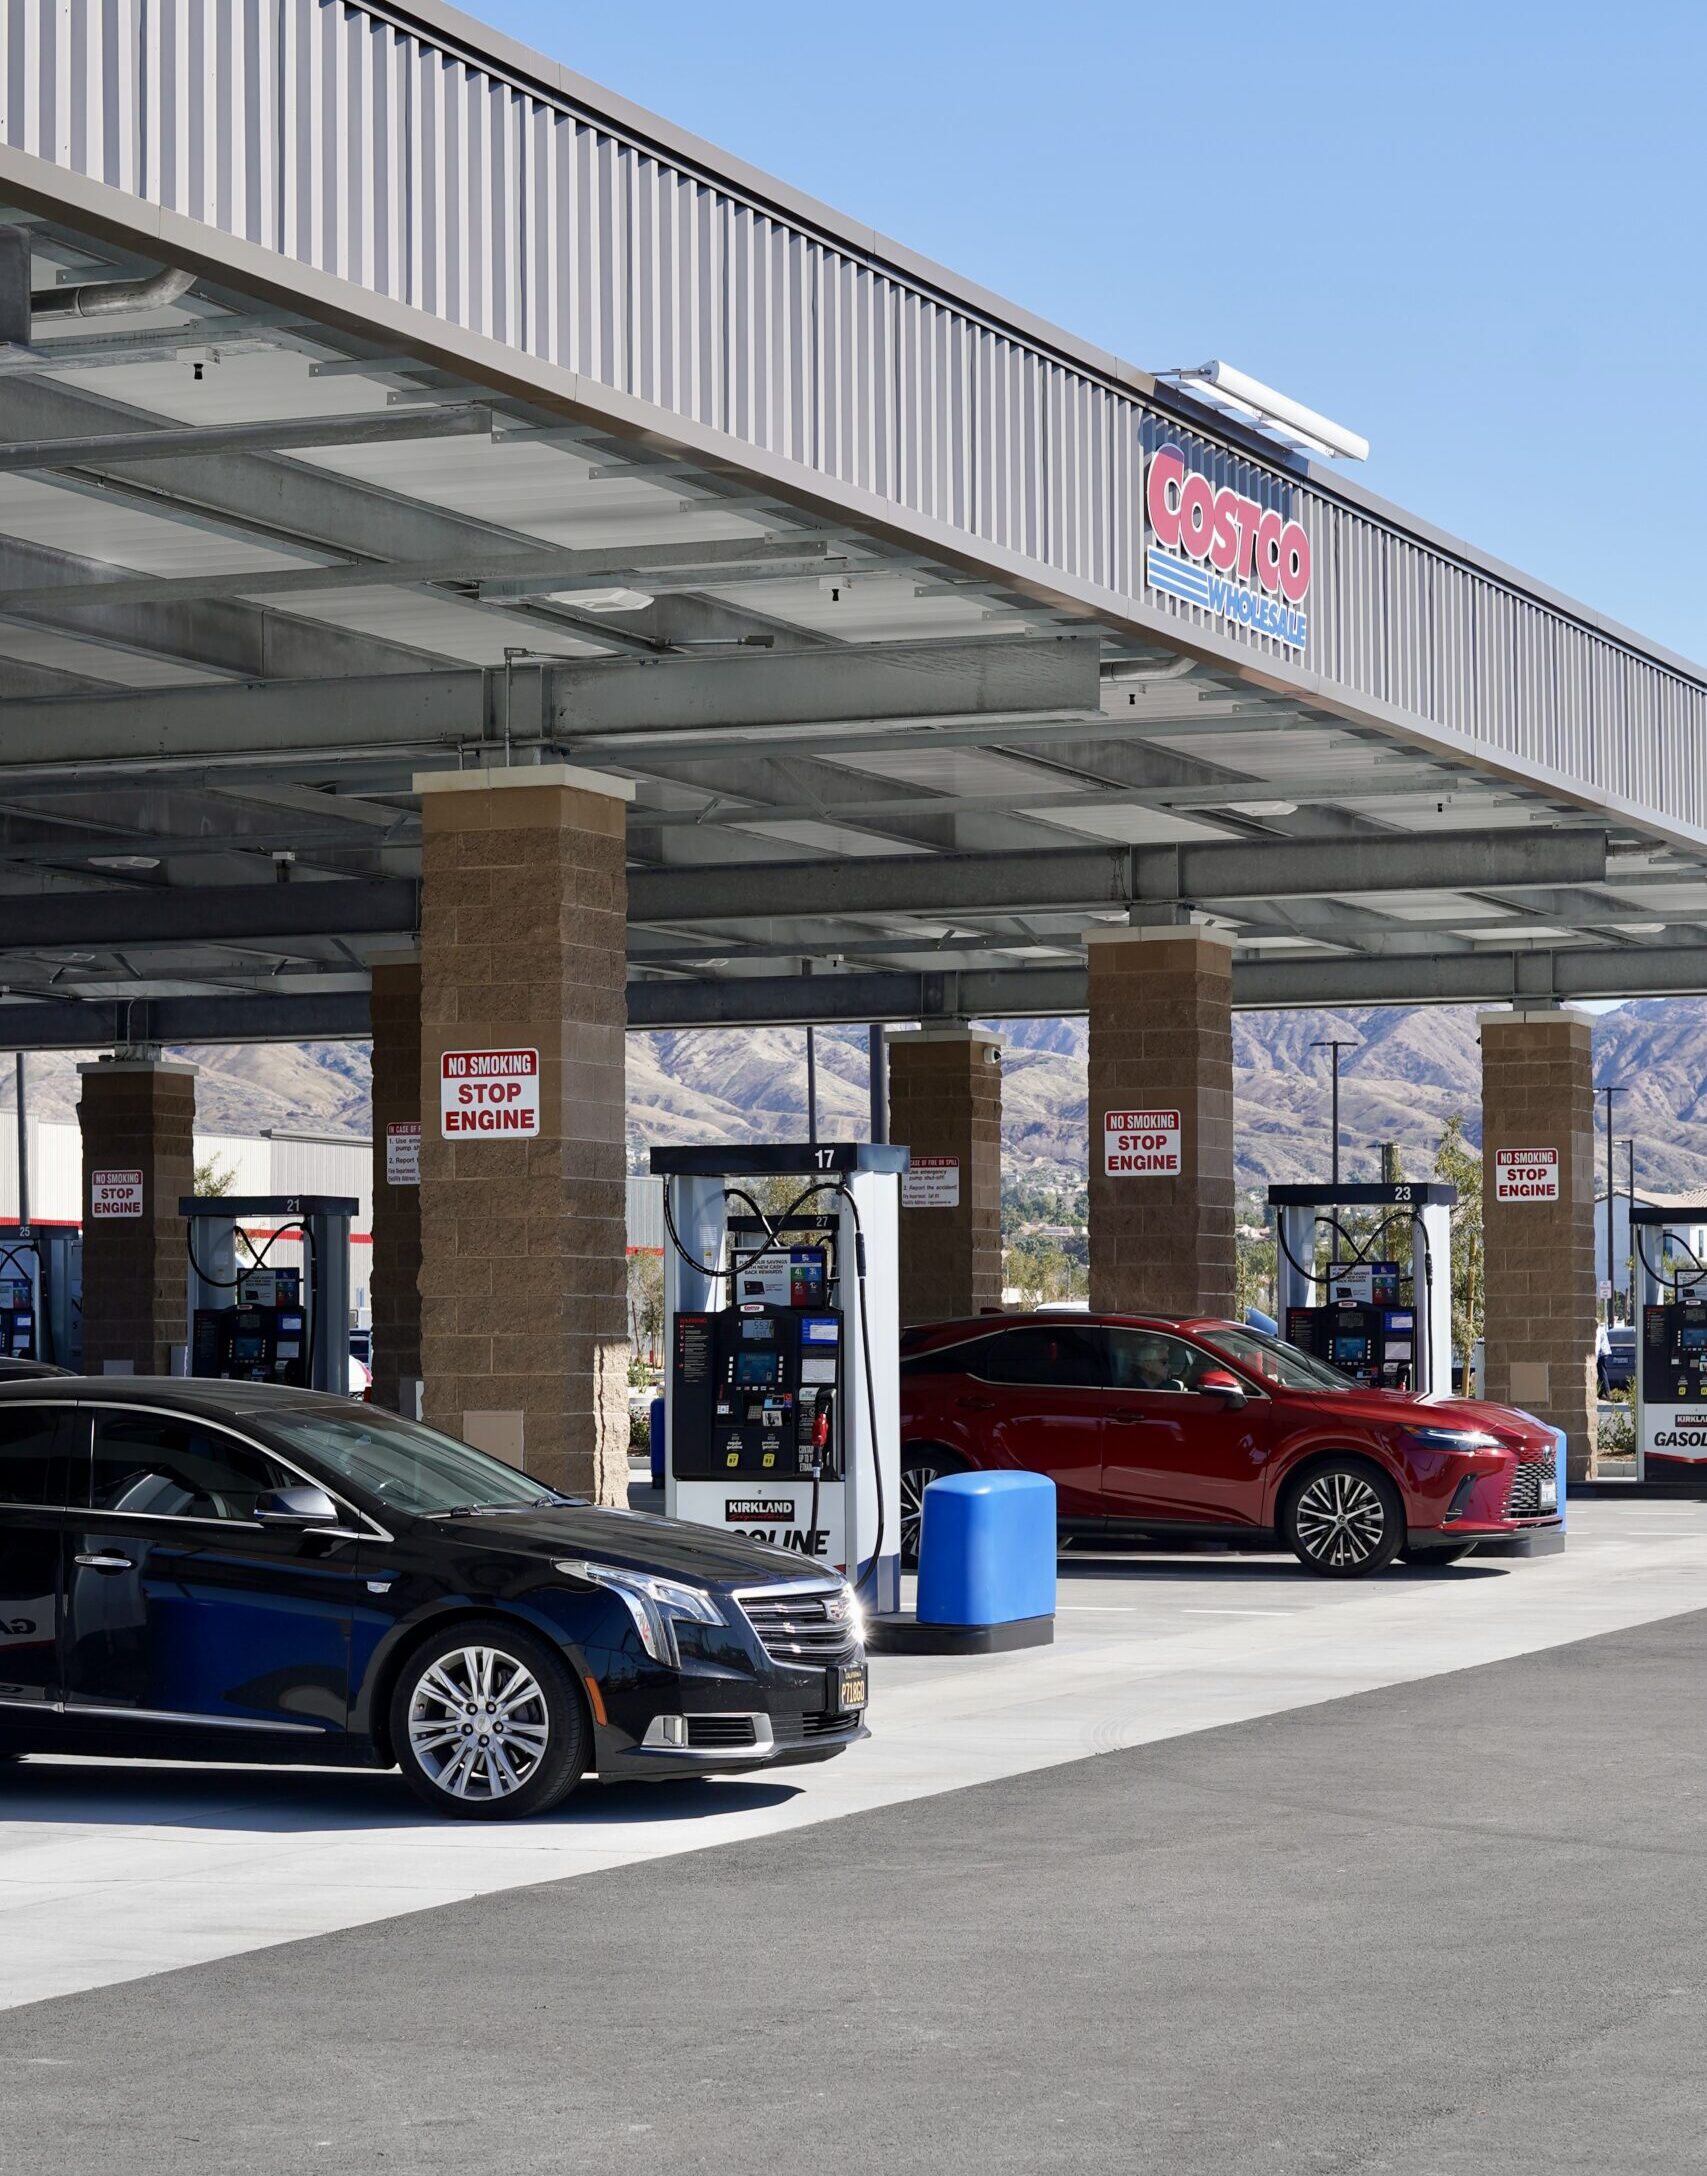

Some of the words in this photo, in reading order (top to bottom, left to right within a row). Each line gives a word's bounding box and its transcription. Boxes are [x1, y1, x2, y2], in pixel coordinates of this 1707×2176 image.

[1147, 443, 1310, 604] COSTCO
[1207, 573, 1307, 651] WHOLESALE
[448, 1057, 466, 1076] NO
[470, 1054, 532, 1075] SMOKING
[458, 1083, 522, 1105] STOP
[445, 1108, 535, 1131] ENGINE
[1110, 1115, 1125, 1130] NO
[1127, 1114, 1175, 1129] SMOKING
[1118, 1135, 1168, 1151] STOP
[815, 1150, 835, 1168] 17
[1108, 1154, 1178, 1170] ENGINE
[1501, 1153, 1513, 1164] NO
[1514, 1152, 1554, 1164] SMOKING
[96, 1174, 106, 1184] NO
[107, 1173, 139, 1184] SMOKING
[1507, 1168, 1547, 1181] STOP
[101, 1188, 134, 1199] STOP
[1394, 1187, 1411, 1201] 23
[1499, 1184, 1556, 1197] ENGINE
[94, 1202, 141, 1214] ENGINE
[287, 1199, 300, 1212] 21
[816, 1216, 829, 1228] 27
[19, 1226, 31, 1238] 25
[1677, 1415, 1707, 1423] KIRKLA
[1654, 1431, 1707, 1447] GASOL
[729, 1502, 792, 1513] KIRKLAND
